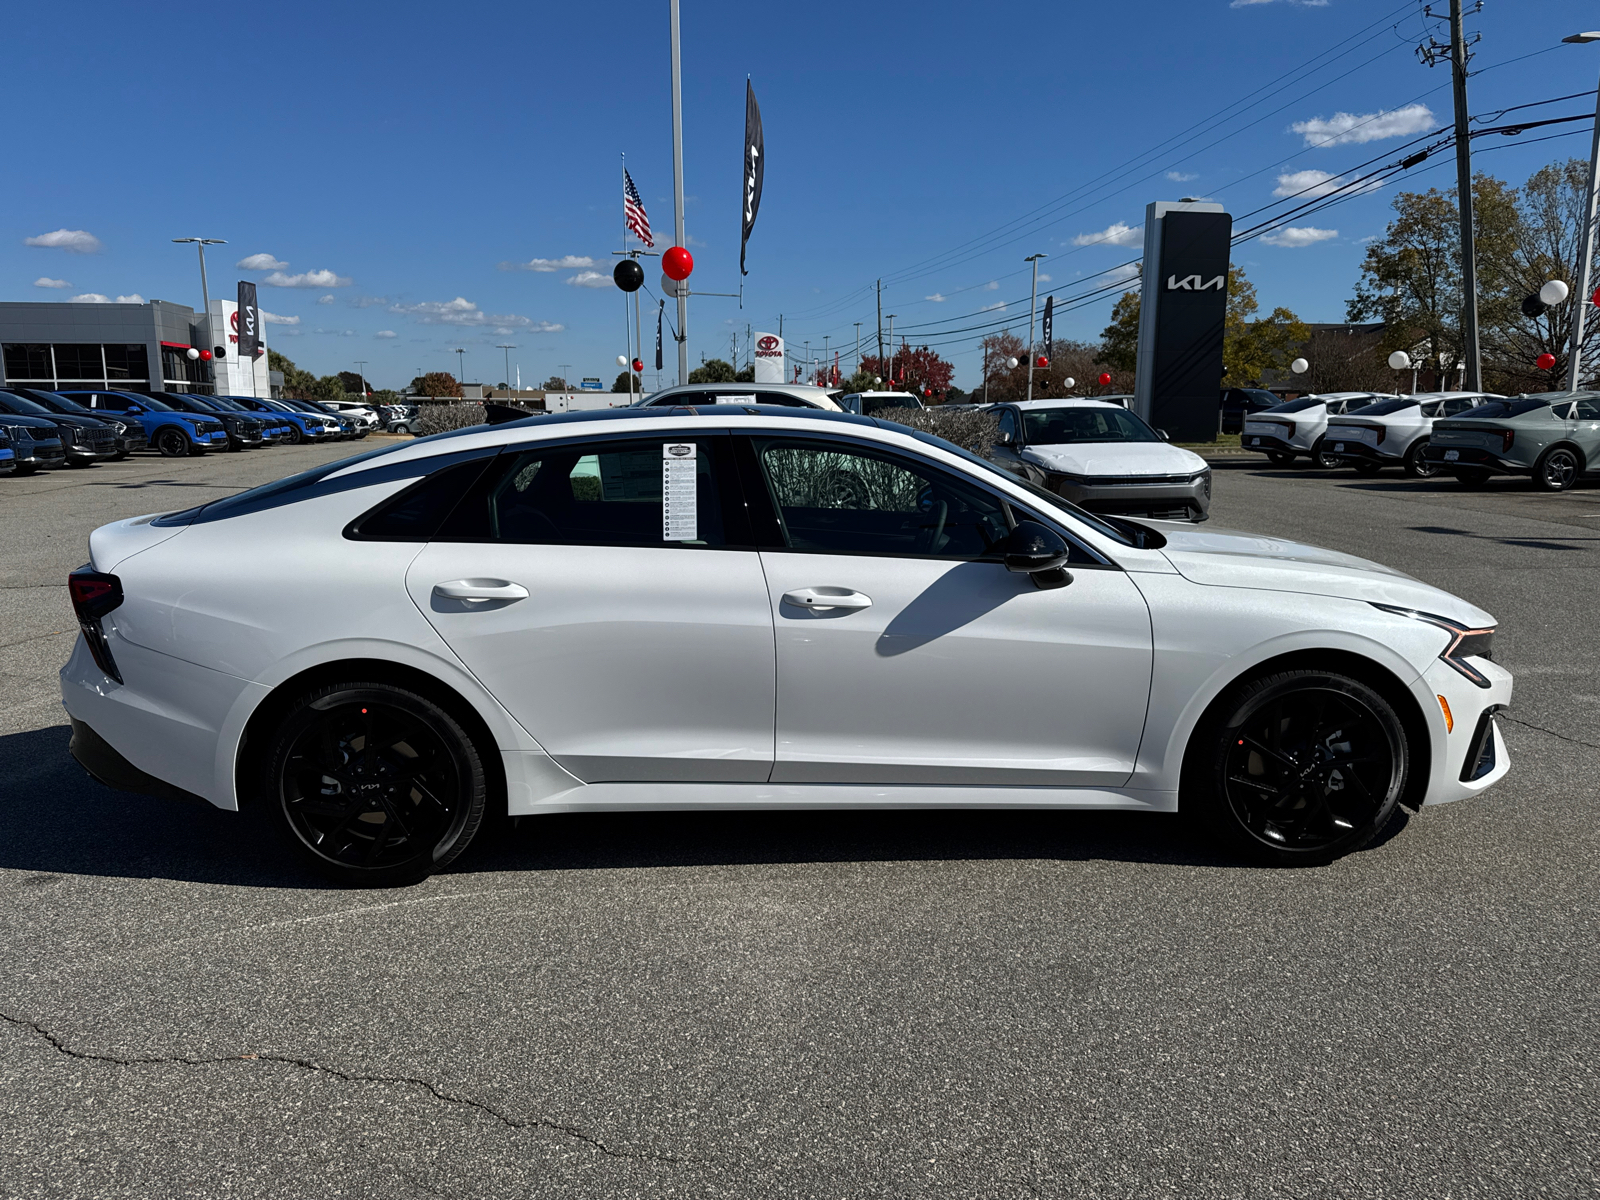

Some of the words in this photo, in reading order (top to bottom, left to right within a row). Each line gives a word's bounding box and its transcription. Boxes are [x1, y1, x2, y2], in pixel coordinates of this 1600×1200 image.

[746, 145, 759, 222] KIA
[1168, 274, 1225, 291] KIA
[246, 306, 254, 335] KIA
[1300, 763, 1316, 778] KIA
